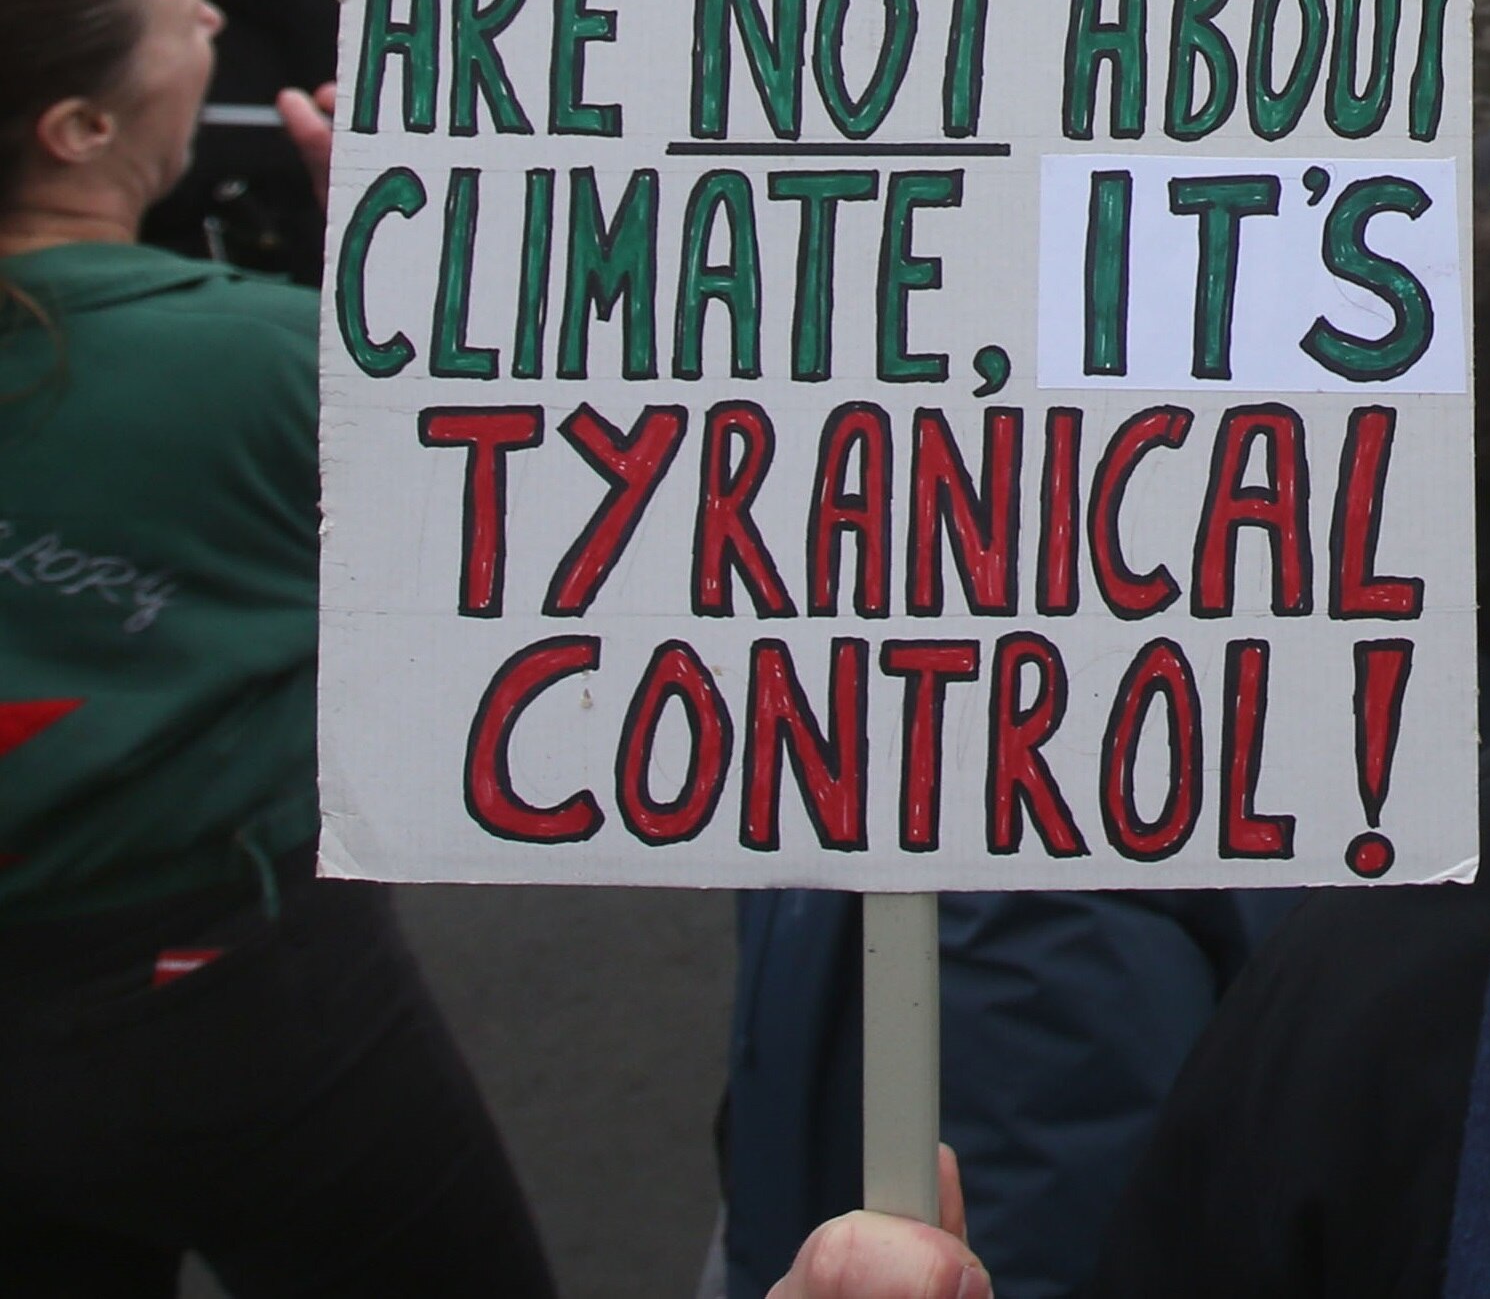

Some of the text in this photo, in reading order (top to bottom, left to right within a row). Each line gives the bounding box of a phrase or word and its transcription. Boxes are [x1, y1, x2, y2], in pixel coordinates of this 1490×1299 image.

[336, 165, 1434, 396] CLIMATE, IT'S
[419, 403, 1423, 620] TYRANICAL
